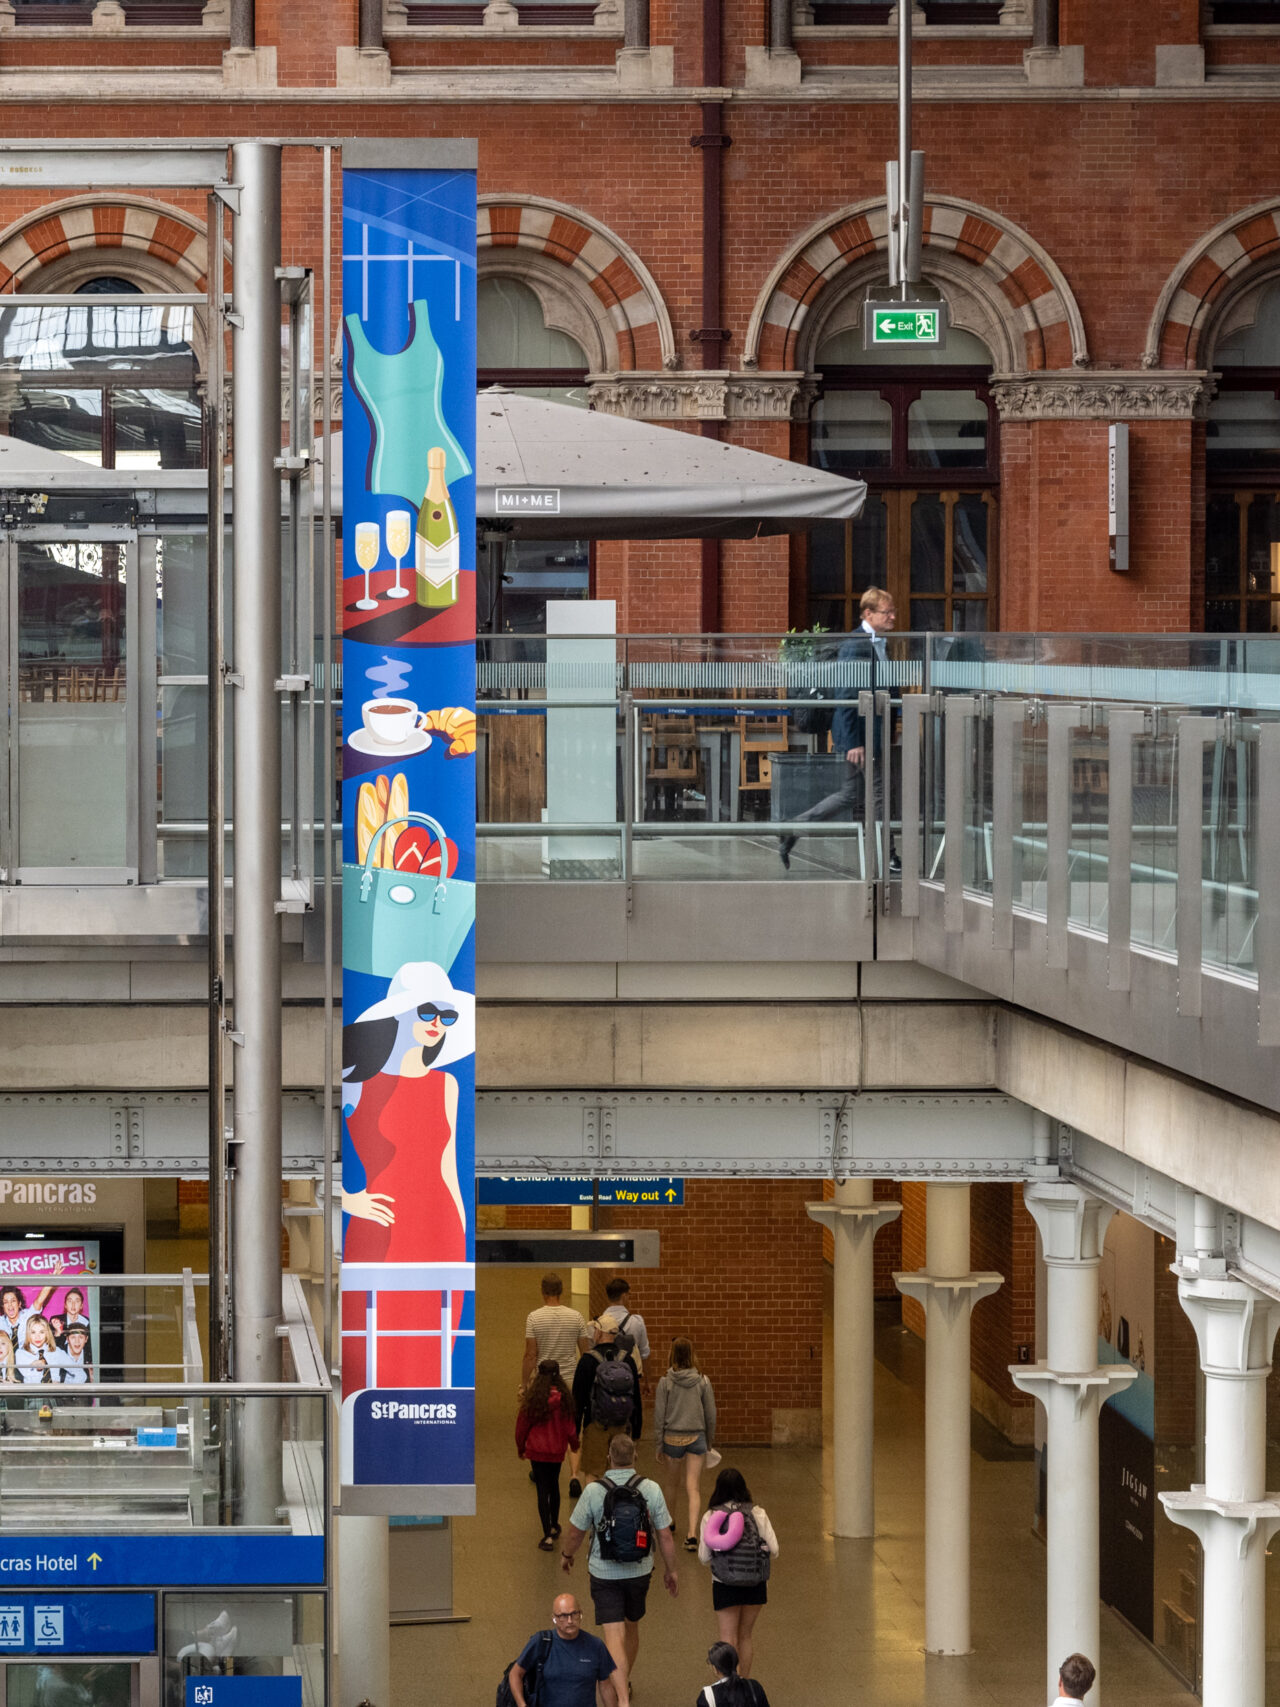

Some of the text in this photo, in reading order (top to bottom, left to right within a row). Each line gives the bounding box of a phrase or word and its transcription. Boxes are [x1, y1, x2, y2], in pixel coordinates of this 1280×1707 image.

[898, 321, 913, 330] Exit
[615, 1190, 639, 1203] Way
[641, 1191, 660, 1201] out
[36, 1554, 78, 1572] Hotel
